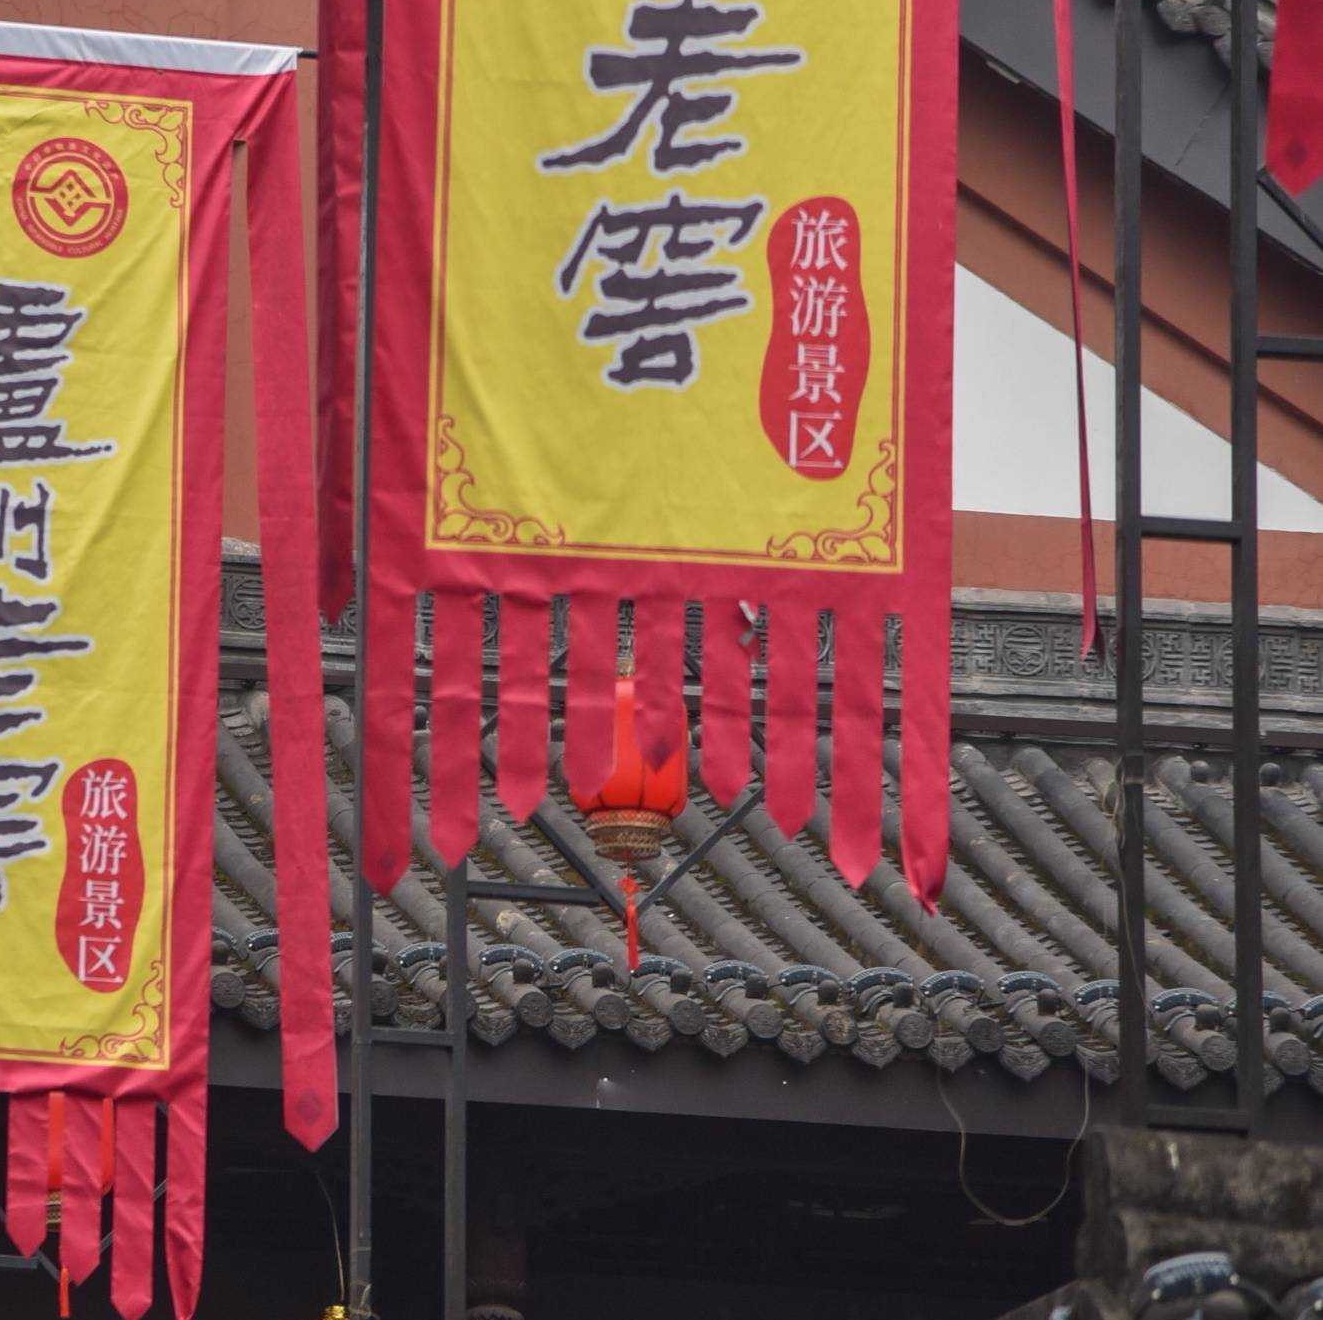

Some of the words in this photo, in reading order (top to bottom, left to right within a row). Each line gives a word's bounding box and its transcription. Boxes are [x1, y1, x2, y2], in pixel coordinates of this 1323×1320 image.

[789, 209, 848, 468] 旅游景区
[78, 769, 127, 984] 旅游景区
